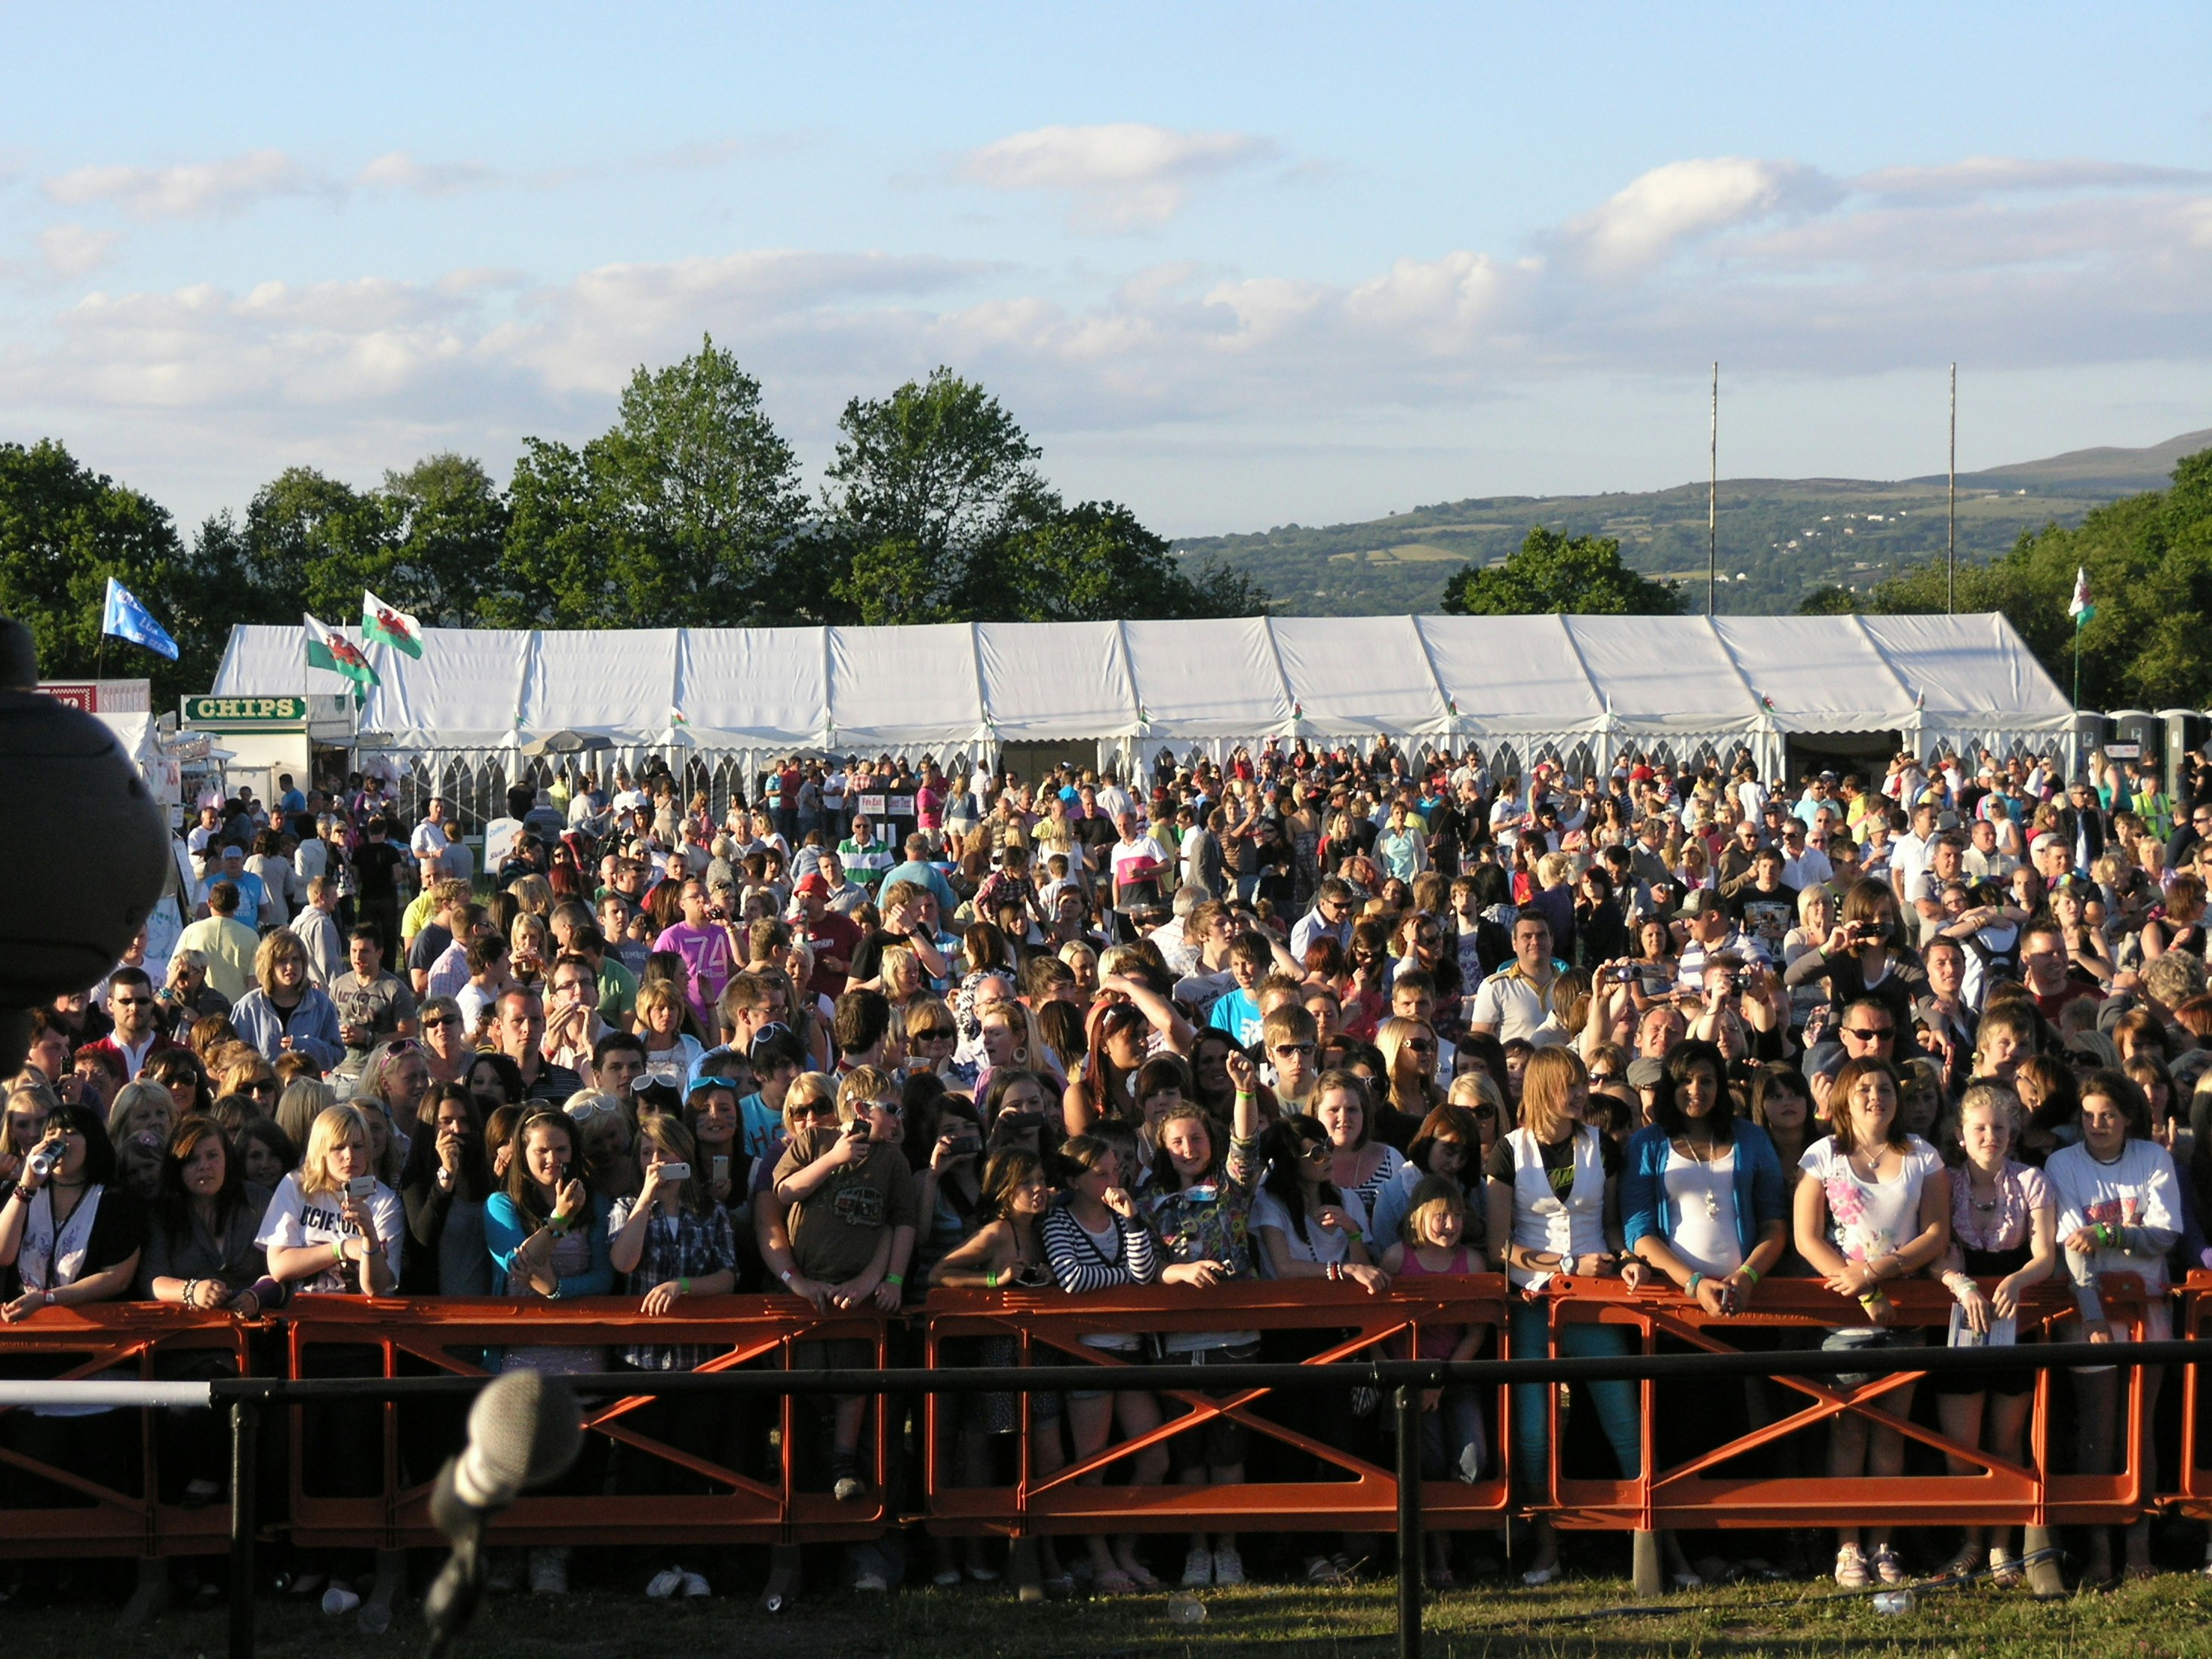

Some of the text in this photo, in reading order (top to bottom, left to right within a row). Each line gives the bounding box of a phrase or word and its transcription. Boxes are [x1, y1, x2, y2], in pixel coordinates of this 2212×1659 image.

[197, 699, 295, 718] CHIPS
[873, 797, 883, 806] Exit
[684, 933, 728, 977] 74
